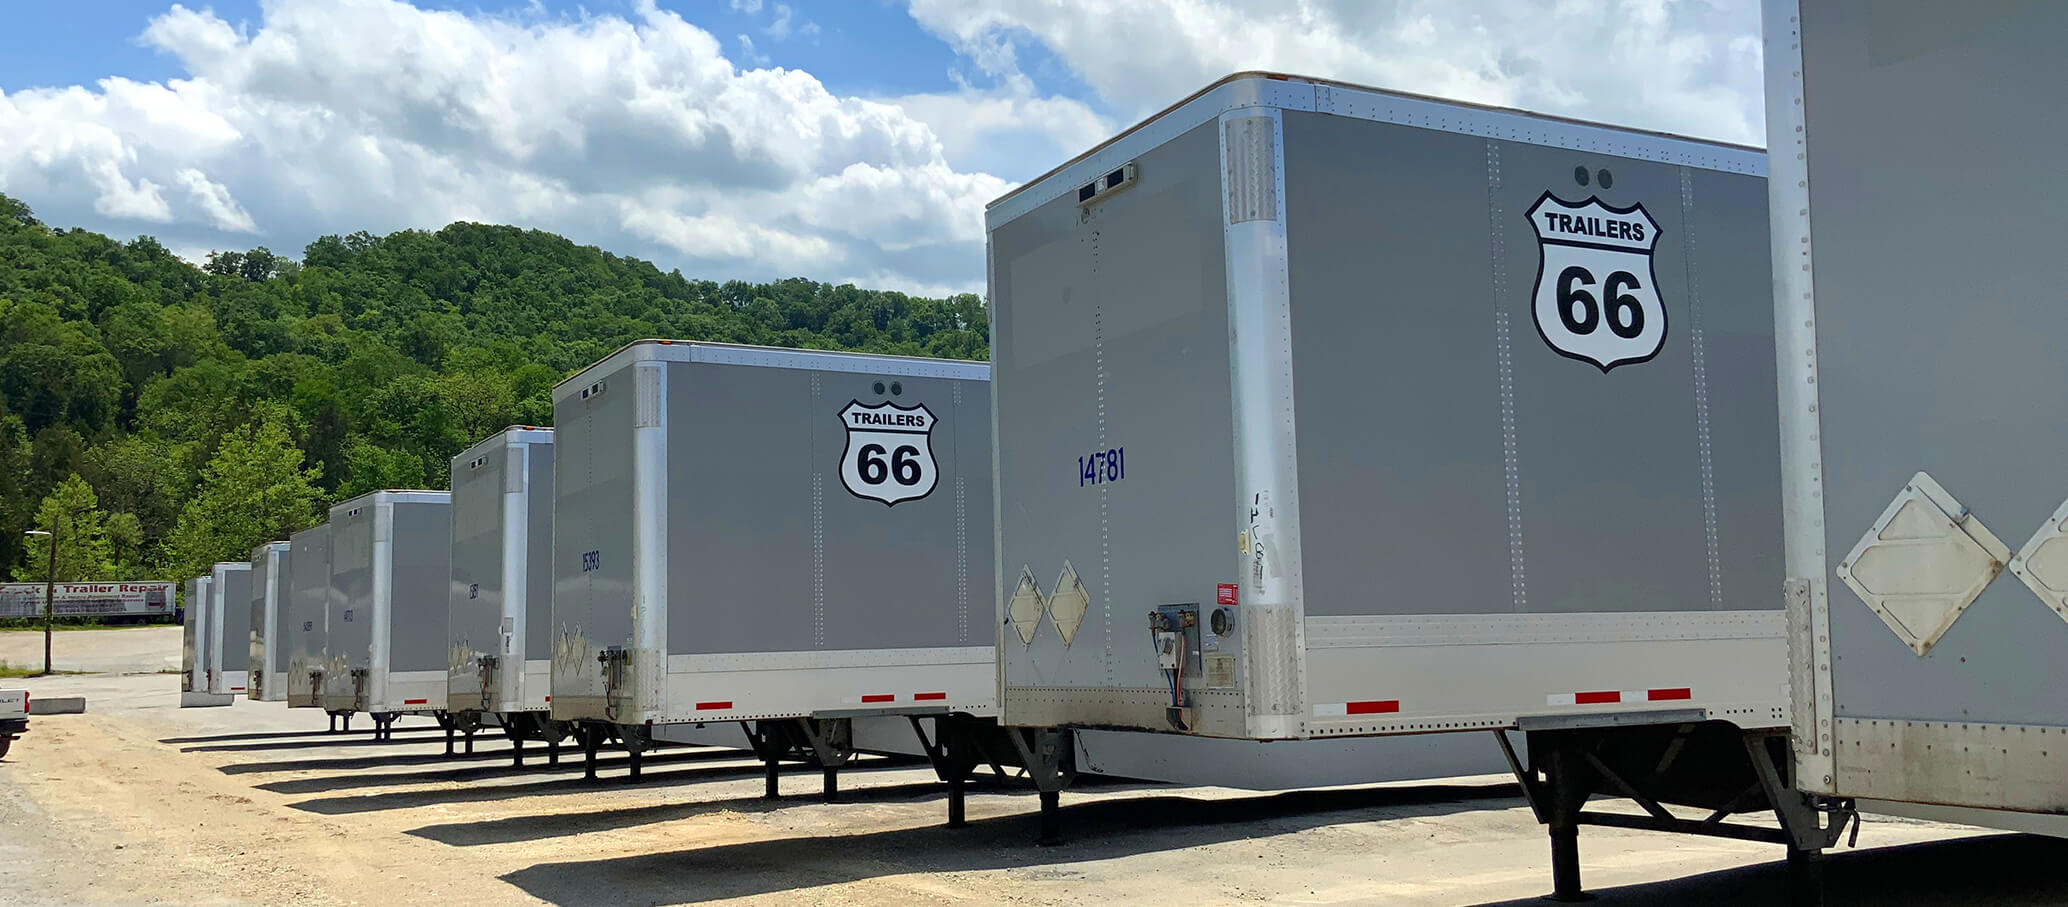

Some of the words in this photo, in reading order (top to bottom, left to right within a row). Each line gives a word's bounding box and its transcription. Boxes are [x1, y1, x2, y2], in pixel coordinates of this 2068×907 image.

[1544, 211, 1645, 242] TRAILERS
[1556, 265, 1645, 339] 66
[851, 412, 925, 427] TRAILERS
[857, 443, 922, 486] 66
[1078, 446, 1125, 487] 14781
[582, 550, 600, 573] 15393
[63, 584, 114, 593] Trailer
[119, 584, 168, 593] Repair
